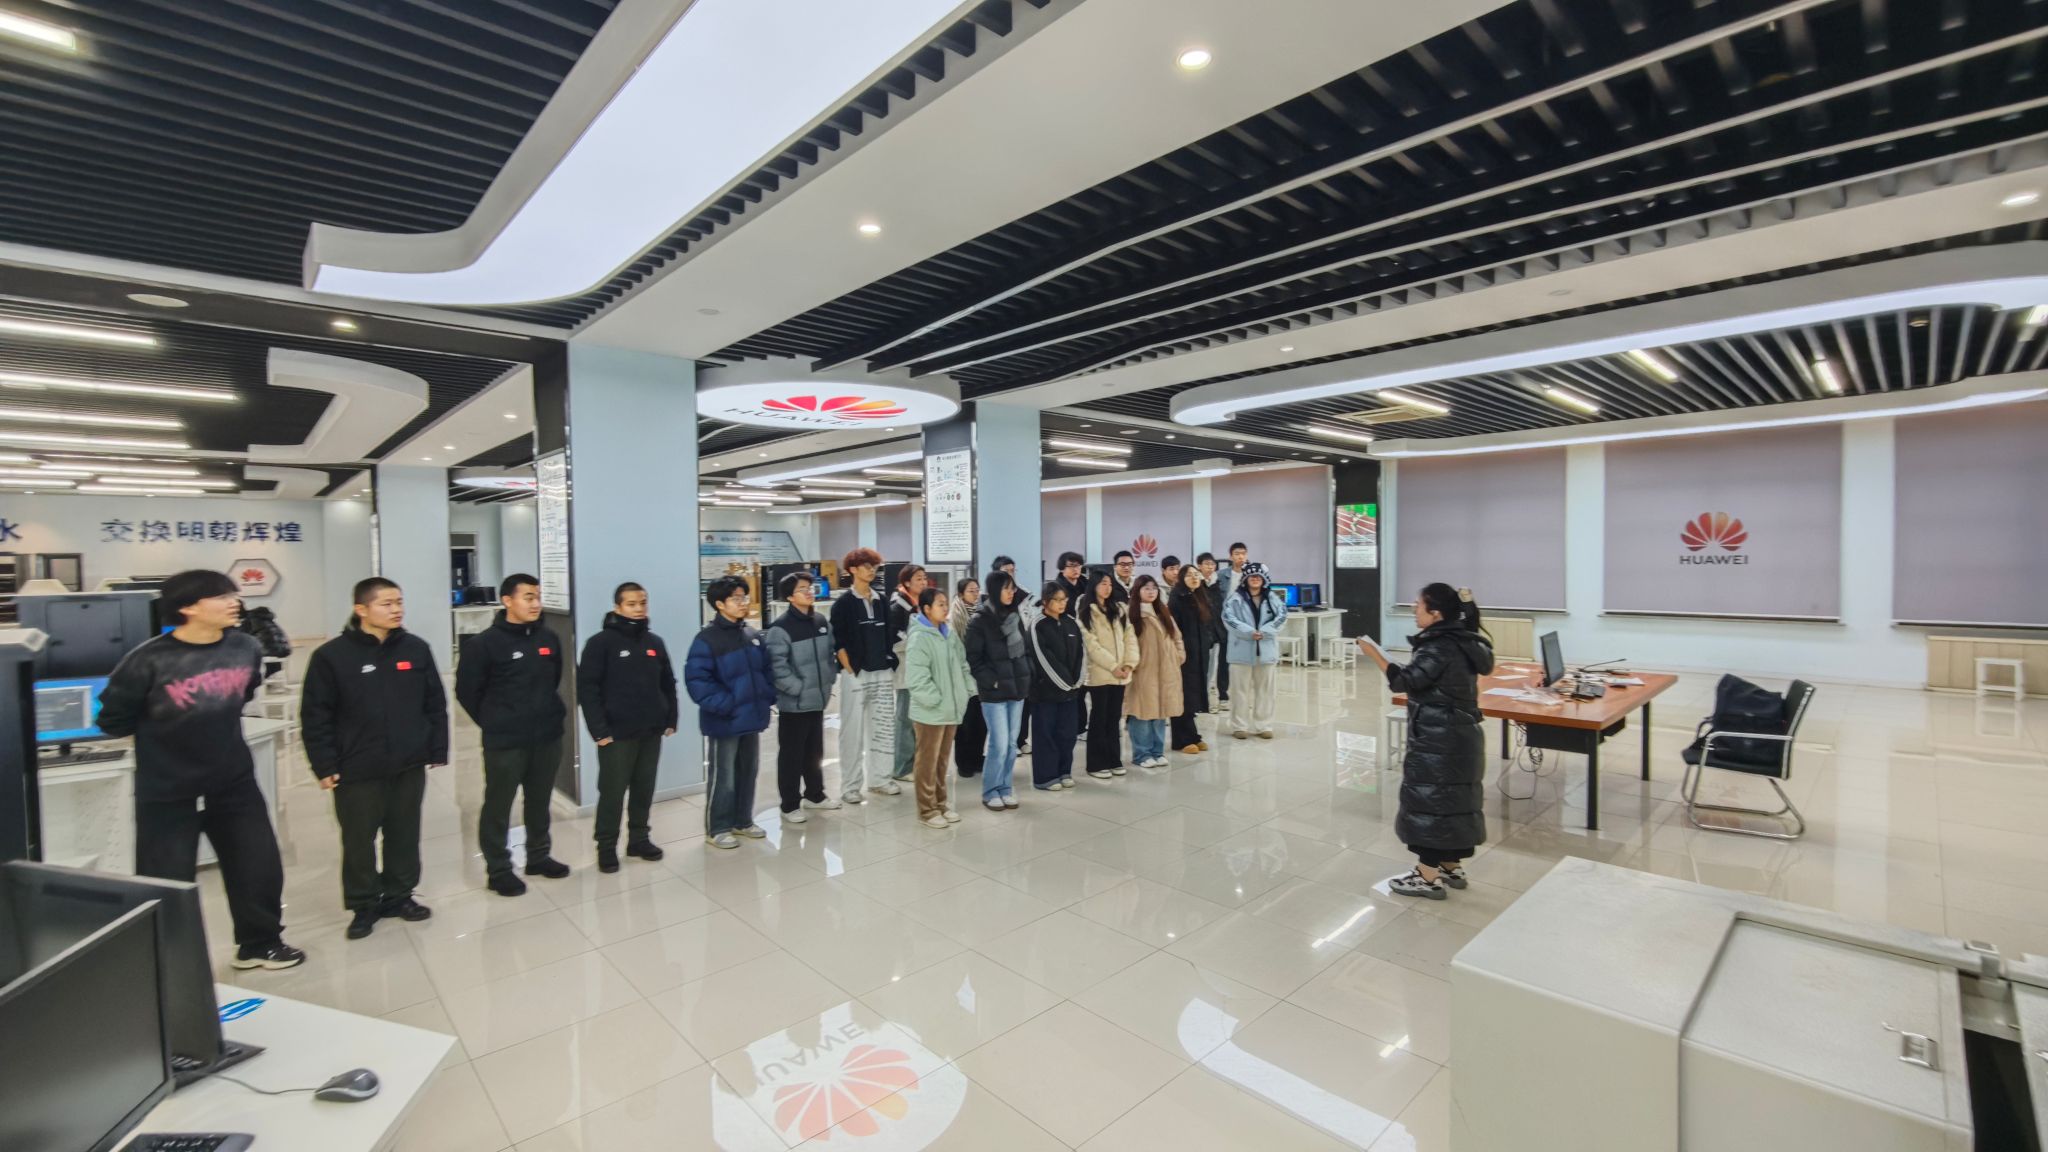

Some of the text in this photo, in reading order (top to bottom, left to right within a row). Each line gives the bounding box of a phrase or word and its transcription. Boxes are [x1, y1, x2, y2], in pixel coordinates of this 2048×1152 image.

[723, 408, 864, 426] HUAWEI
[100, 518, 304, 543] 交换明朝辉煌
[1679, 555, 1749, 565] HUAWEI
